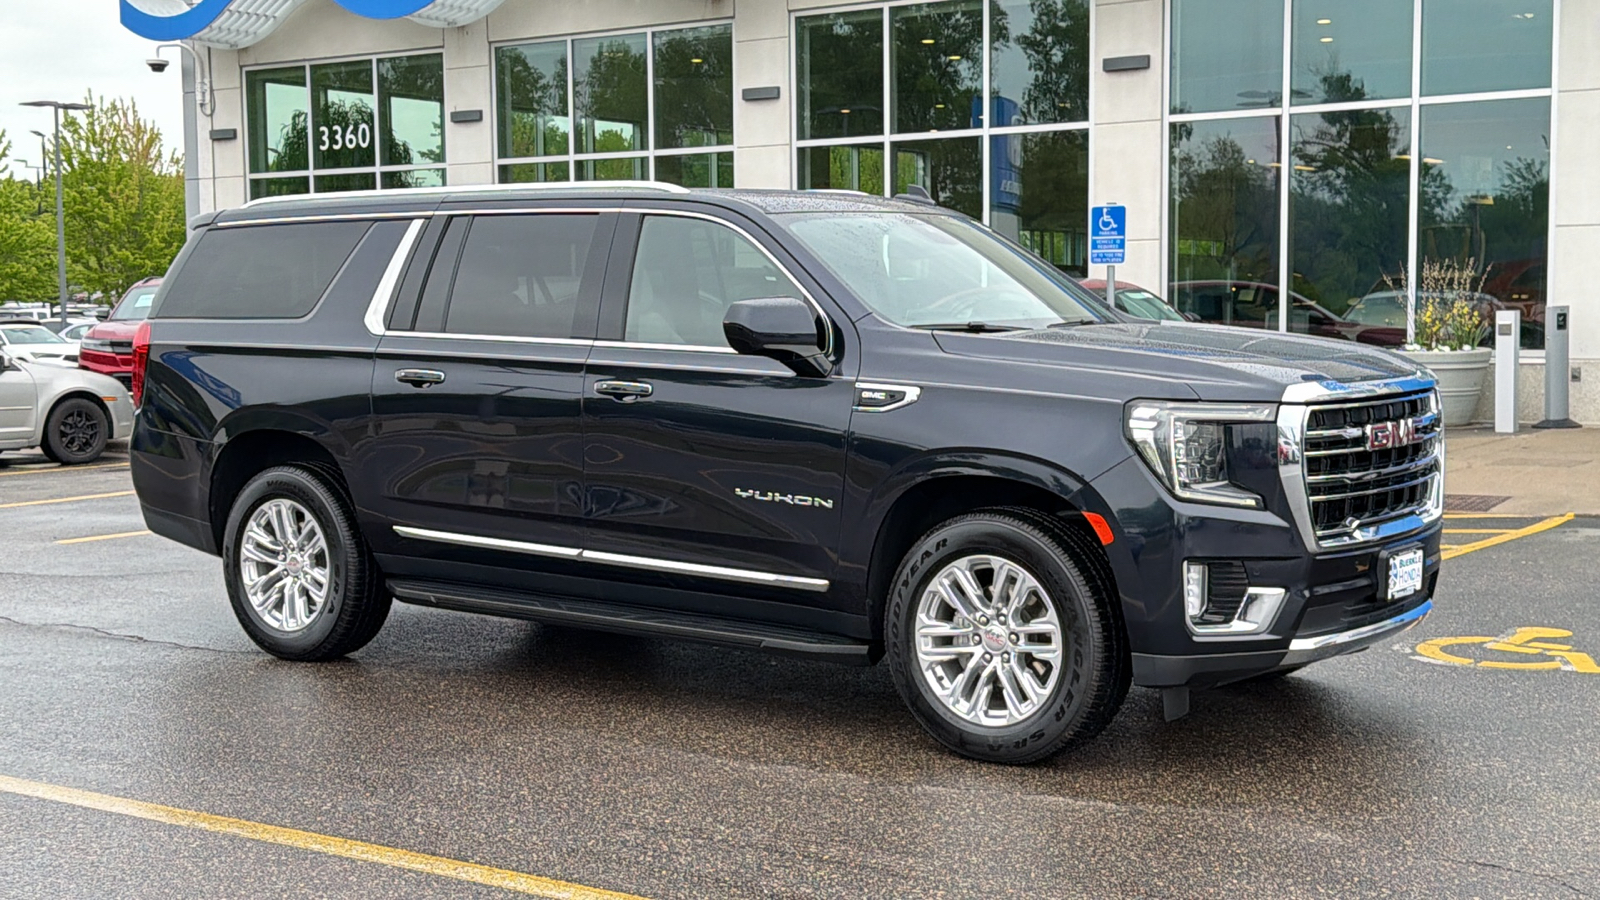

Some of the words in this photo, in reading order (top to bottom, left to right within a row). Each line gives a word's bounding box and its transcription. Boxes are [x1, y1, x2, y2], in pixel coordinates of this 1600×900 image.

[319, 123, 370, 151] 3360
[861, 391, 886, 400] GMC
[1366, 419, 1424, 450] GMC
[734, 487, 834, 509] YUKON
[1399, 555, 1422, 569] BUERKLE
[1398, 566, 1421, 585] HONDA
[892, 537, 948, 676] GOODYEAR
